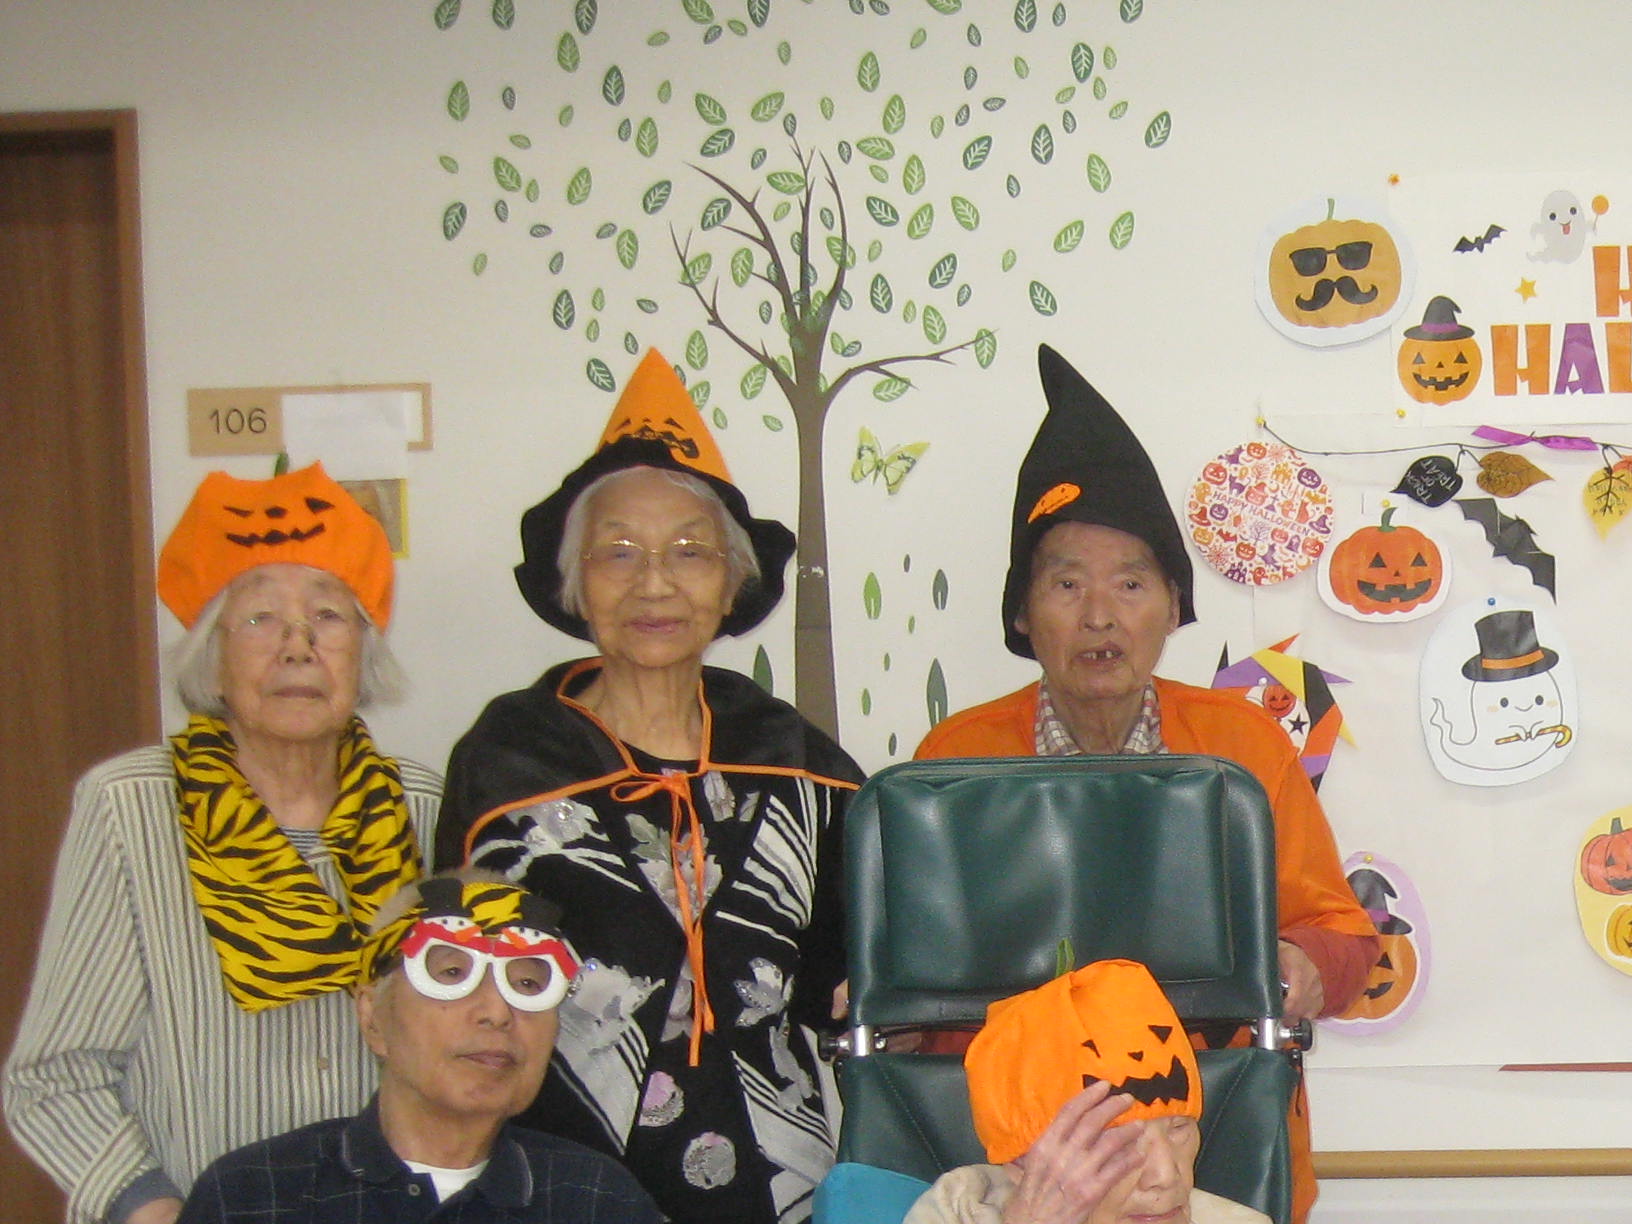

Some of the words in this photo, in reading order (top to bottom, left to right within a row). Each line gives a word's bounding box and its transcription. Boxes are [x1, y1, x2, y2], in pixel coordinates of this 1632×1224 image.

[209, 408, 267, 435] 106
[1213, 490, 1249, 511] HAPPY
[1250, 504, 1310, 536] HALLOWEEN
